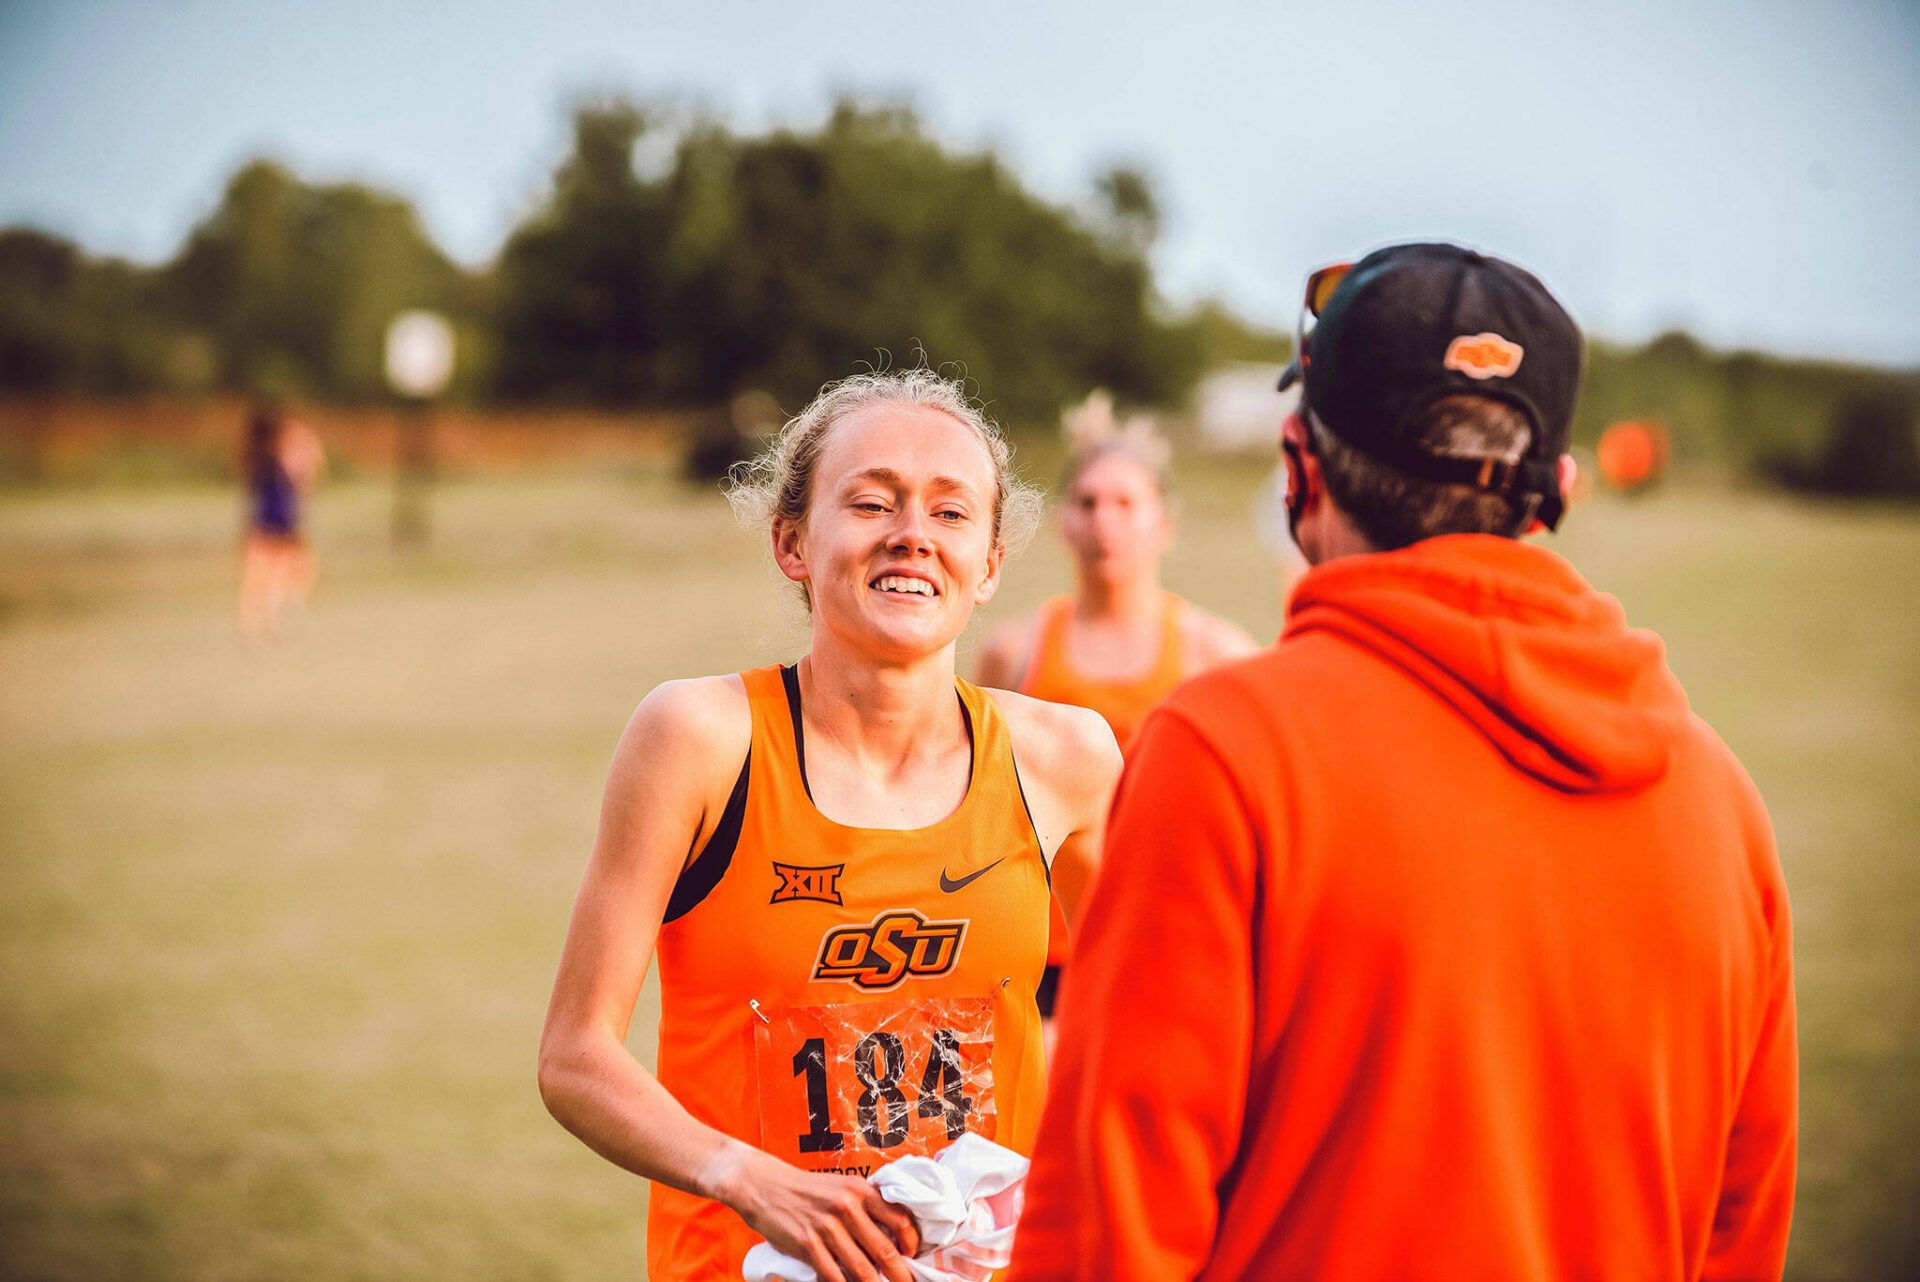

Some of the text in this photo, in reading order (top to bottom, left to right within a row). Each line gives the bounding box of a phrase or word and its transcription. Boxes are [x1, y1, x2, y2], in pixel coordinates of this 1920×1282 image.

[769, 861, 845, 906] XII
[812, 912, 965, 989] OSU
[792, 1029, 973, 1153] 184
